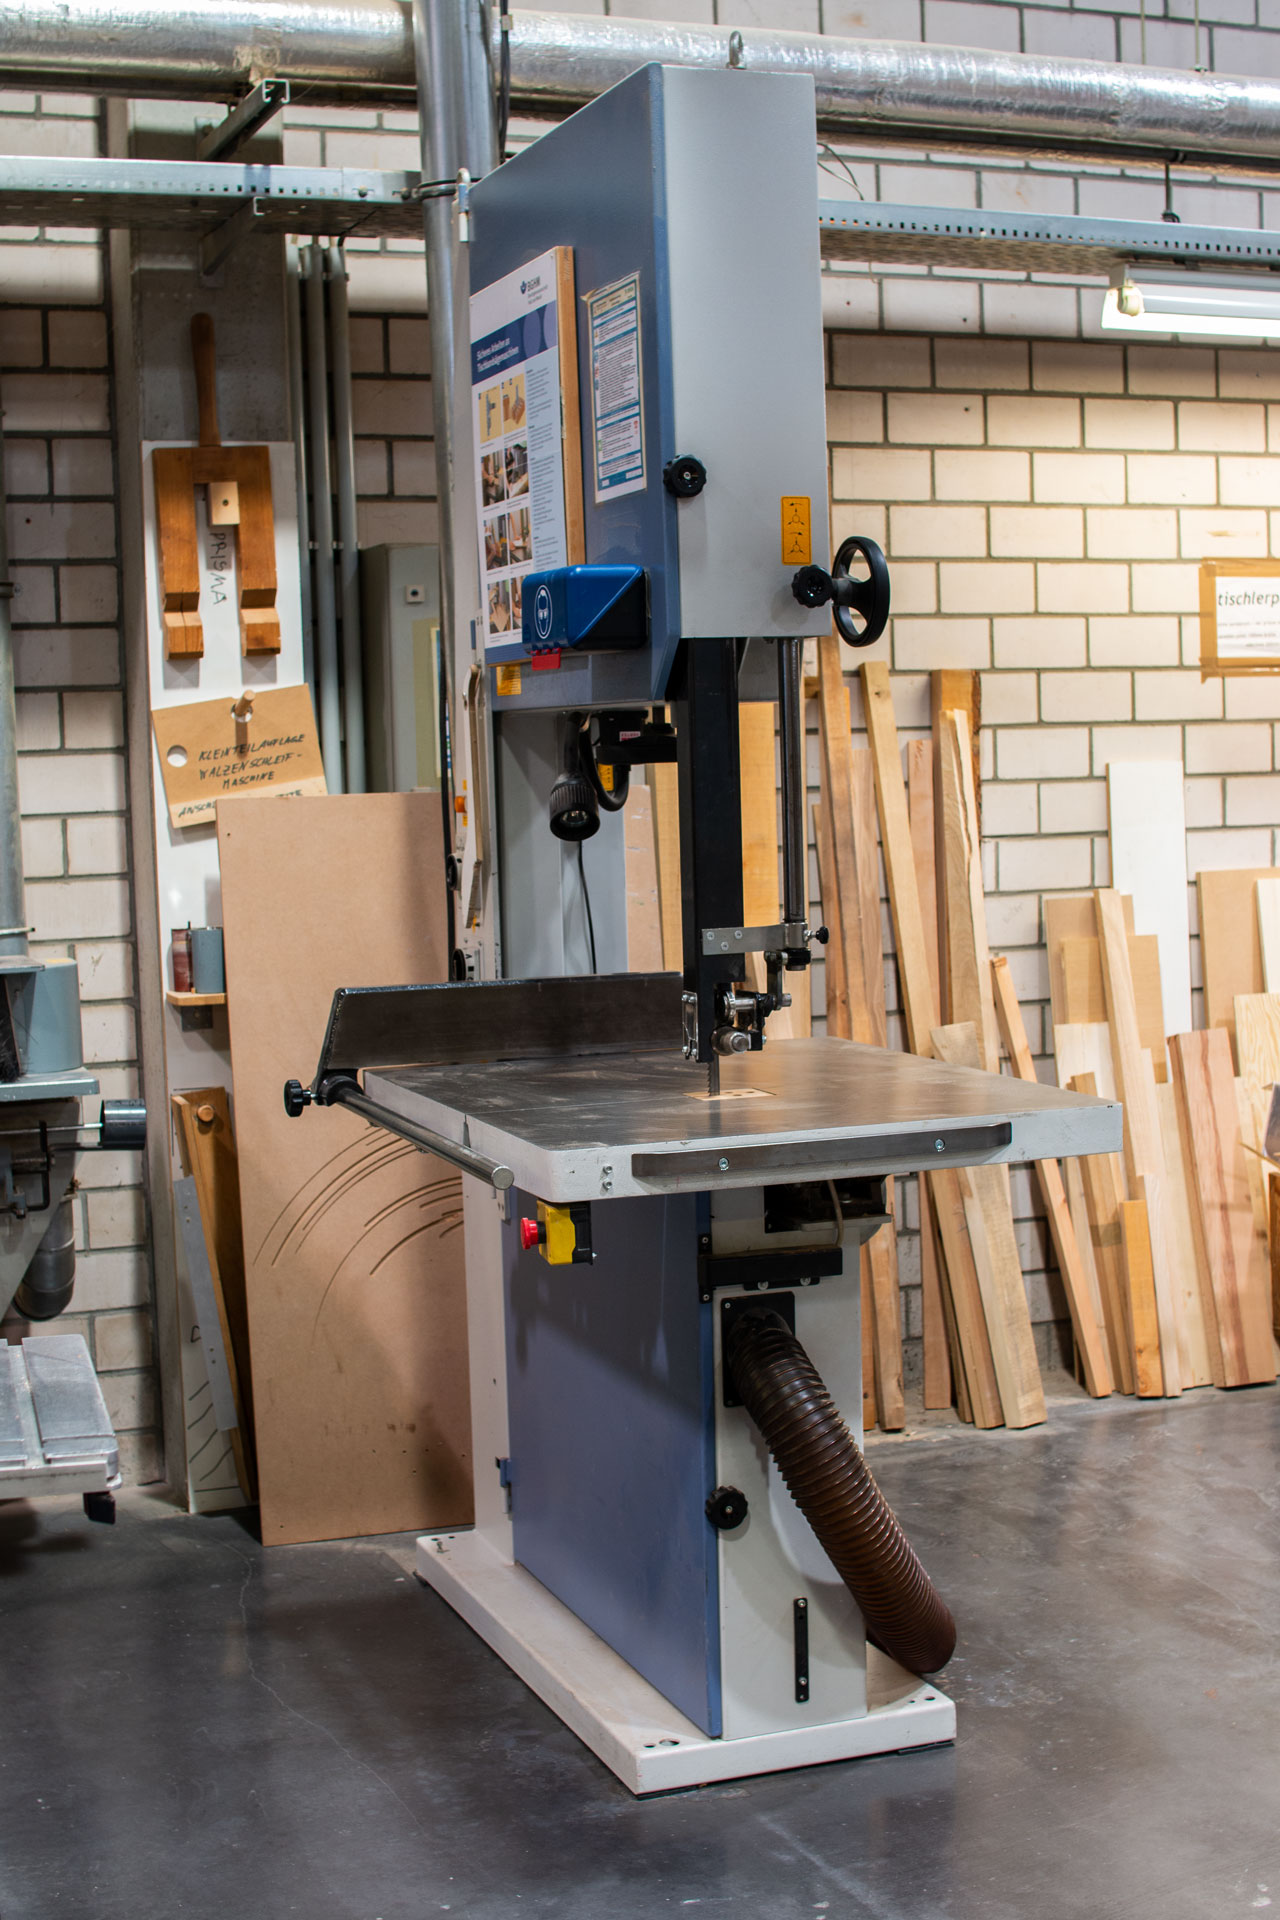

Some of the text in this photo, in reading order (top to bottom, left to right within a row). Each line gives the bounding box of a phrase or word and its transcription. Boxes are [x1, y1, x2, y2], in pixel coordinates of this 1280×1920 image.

[209, 532, 228, 605] PRISMA
[1218, 591, 1280, 608] tischlerp
[198, 733, 305, 761] KLEINTEILAUFLAGE
[222, 770, 275, 789] MASCHINE
